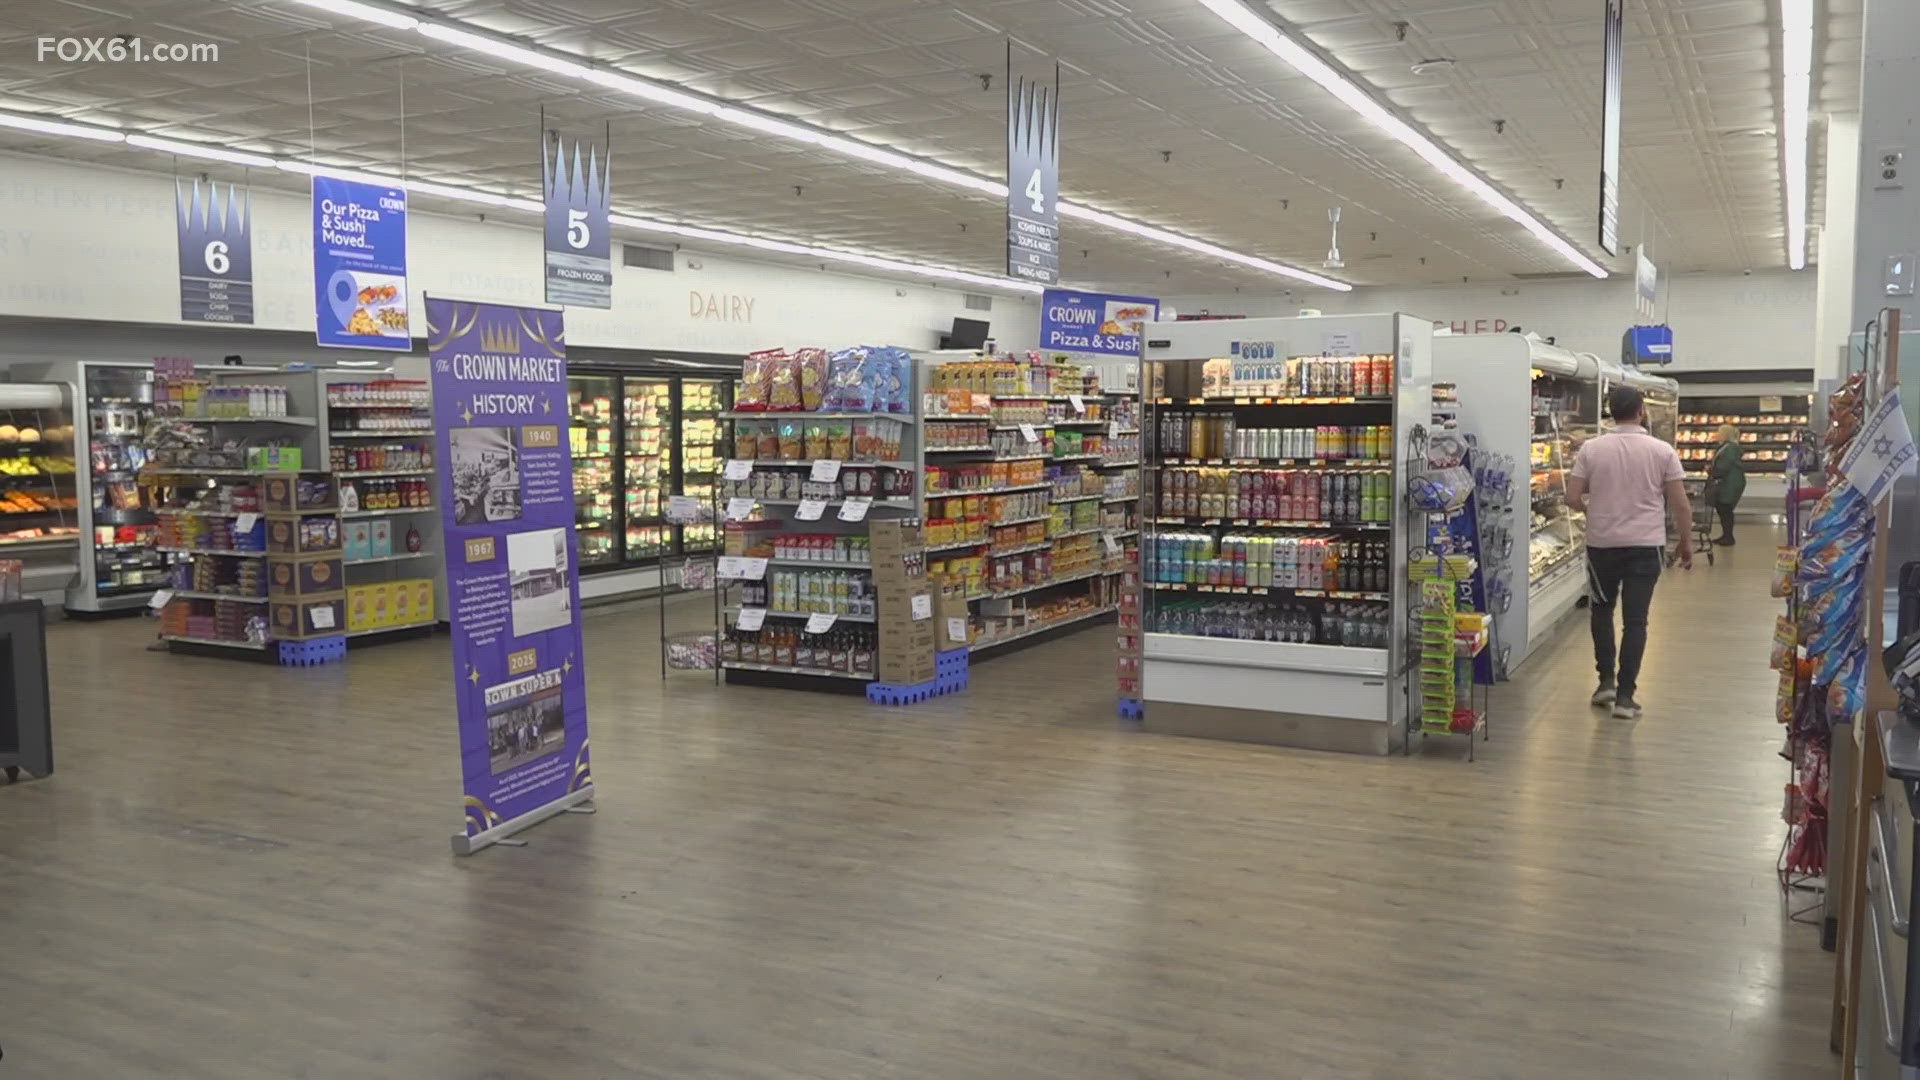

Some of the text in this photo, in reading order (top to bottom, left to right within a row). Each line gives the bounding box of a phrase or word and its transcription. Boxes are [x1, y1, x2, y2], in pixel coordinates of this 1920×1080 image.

[1025, 168, 1044, 214] 4
[321, 199, 380, 222] Our Pizza
[379, 197, 404, 211] CROWN
[321, 214, 366, 233] & Sushi
[567, 208, 590, 249] 5
[322, 229, 375, 250] Moved...
[204, 240, 230, 274] 6
[557, 268, 605, 282] FROZEN FOODS
[209, 281, 228, 290] DAIRY
[209, 292, 229, 300] SODA
[209, 303, 229, 311] CHIPS
[689, 290, 756, 323] DAIRY
[1049, 306, 1096, 325] CROWN
[203, 312, 234, 322] COOKIES
[1433, 318, 1507, 335] HER
[1050, 331, 1089, 348] Pizza
[1091, 334, 1103, 349] &
[1242, 341, 1275, 360] COLD
[435, 354, 562, 383] The CROWN MARKET
[1234, 362, 1282, 381] DRINKS
[473, 393, 535, 415] HISTORY
[528, 431, 551, 442] 1940
[468, 542, 492, 557] 1967
[511, 653, 534, 670] 2025
[520, 674, 553, 696] SUPER
